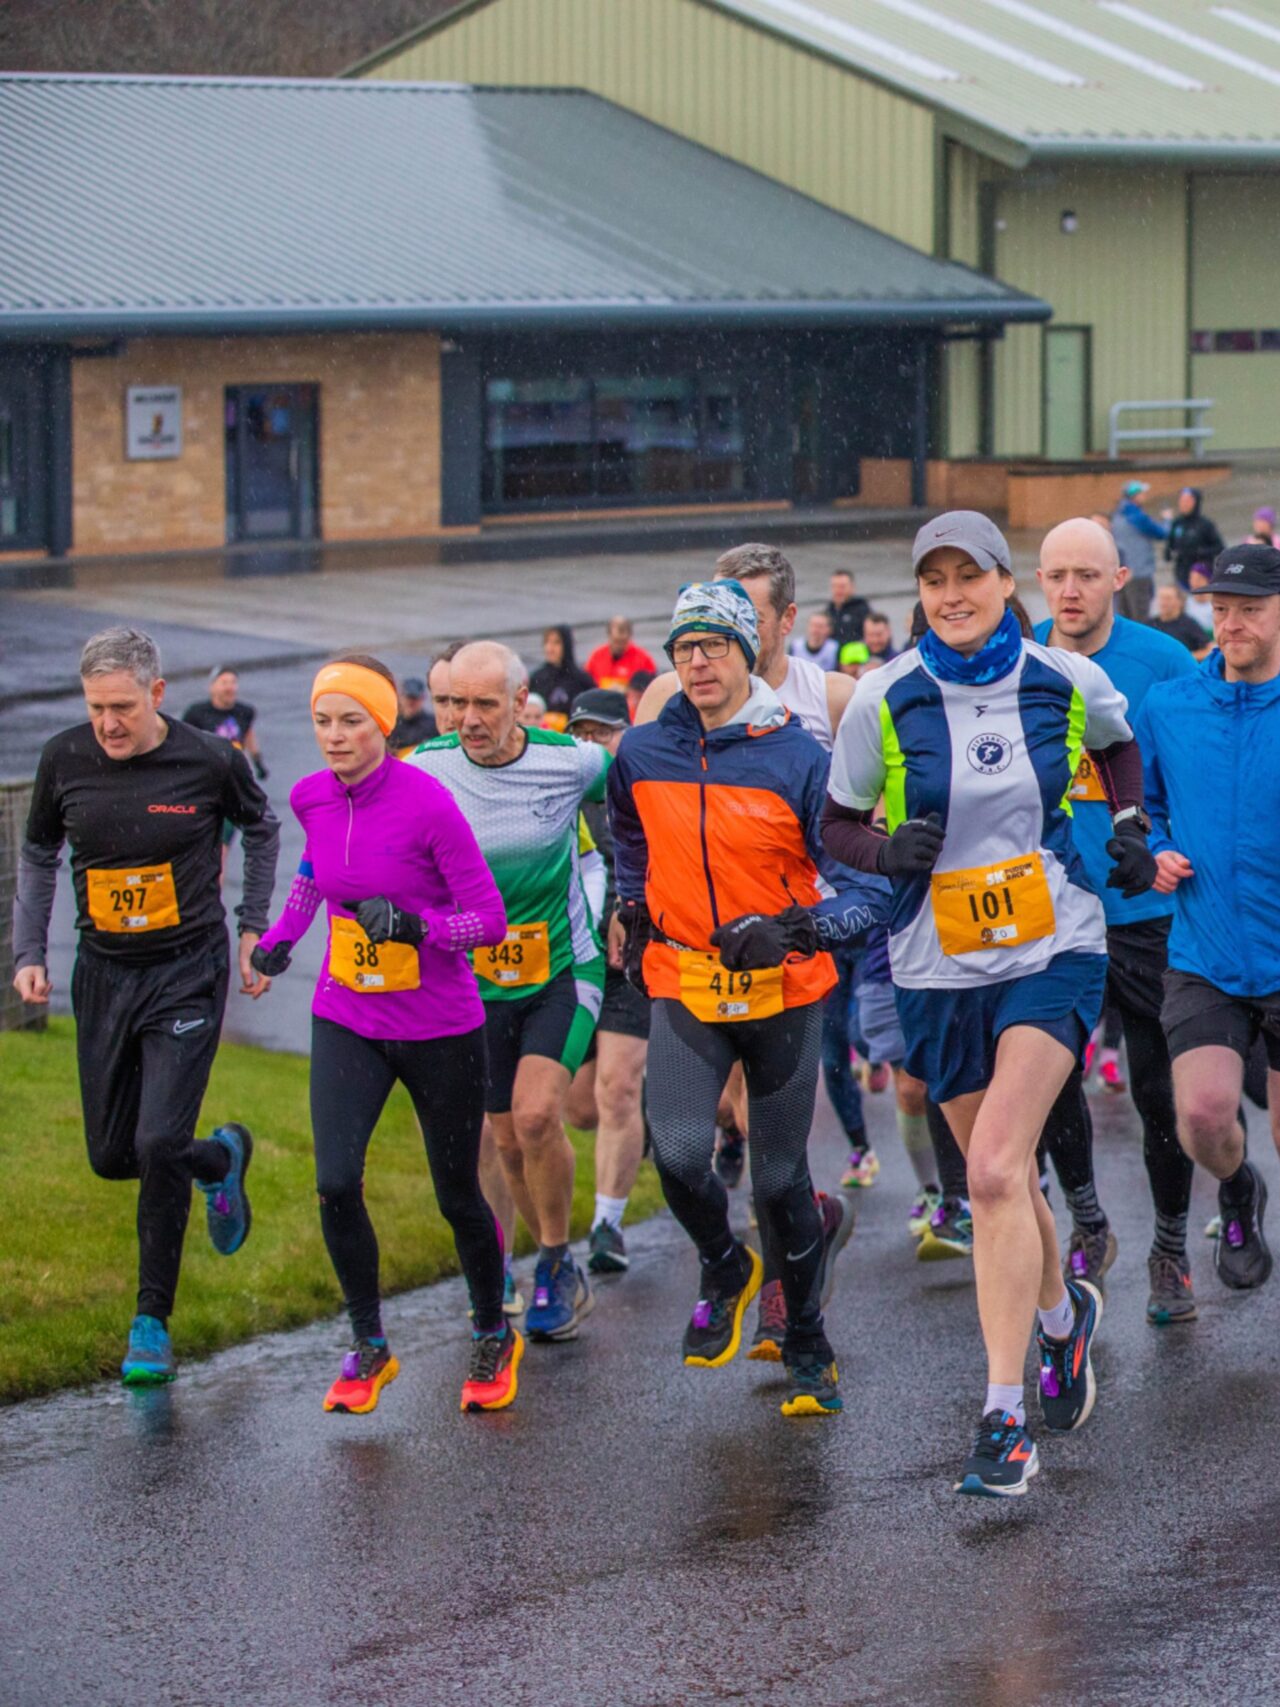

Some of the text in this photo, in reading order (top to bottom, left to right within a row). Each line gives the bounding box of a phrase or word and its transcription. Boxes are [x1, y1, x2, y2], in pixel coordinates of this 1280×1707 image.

[147, 803, 198, 815] ORACLE
[110, 887, 147, 912] 297
[968, 887, 1014, 922] 101
[354, 941, 379, 968] 38
[487, 943, 523, 965] 343
[709, 971, 753, 996] 419
